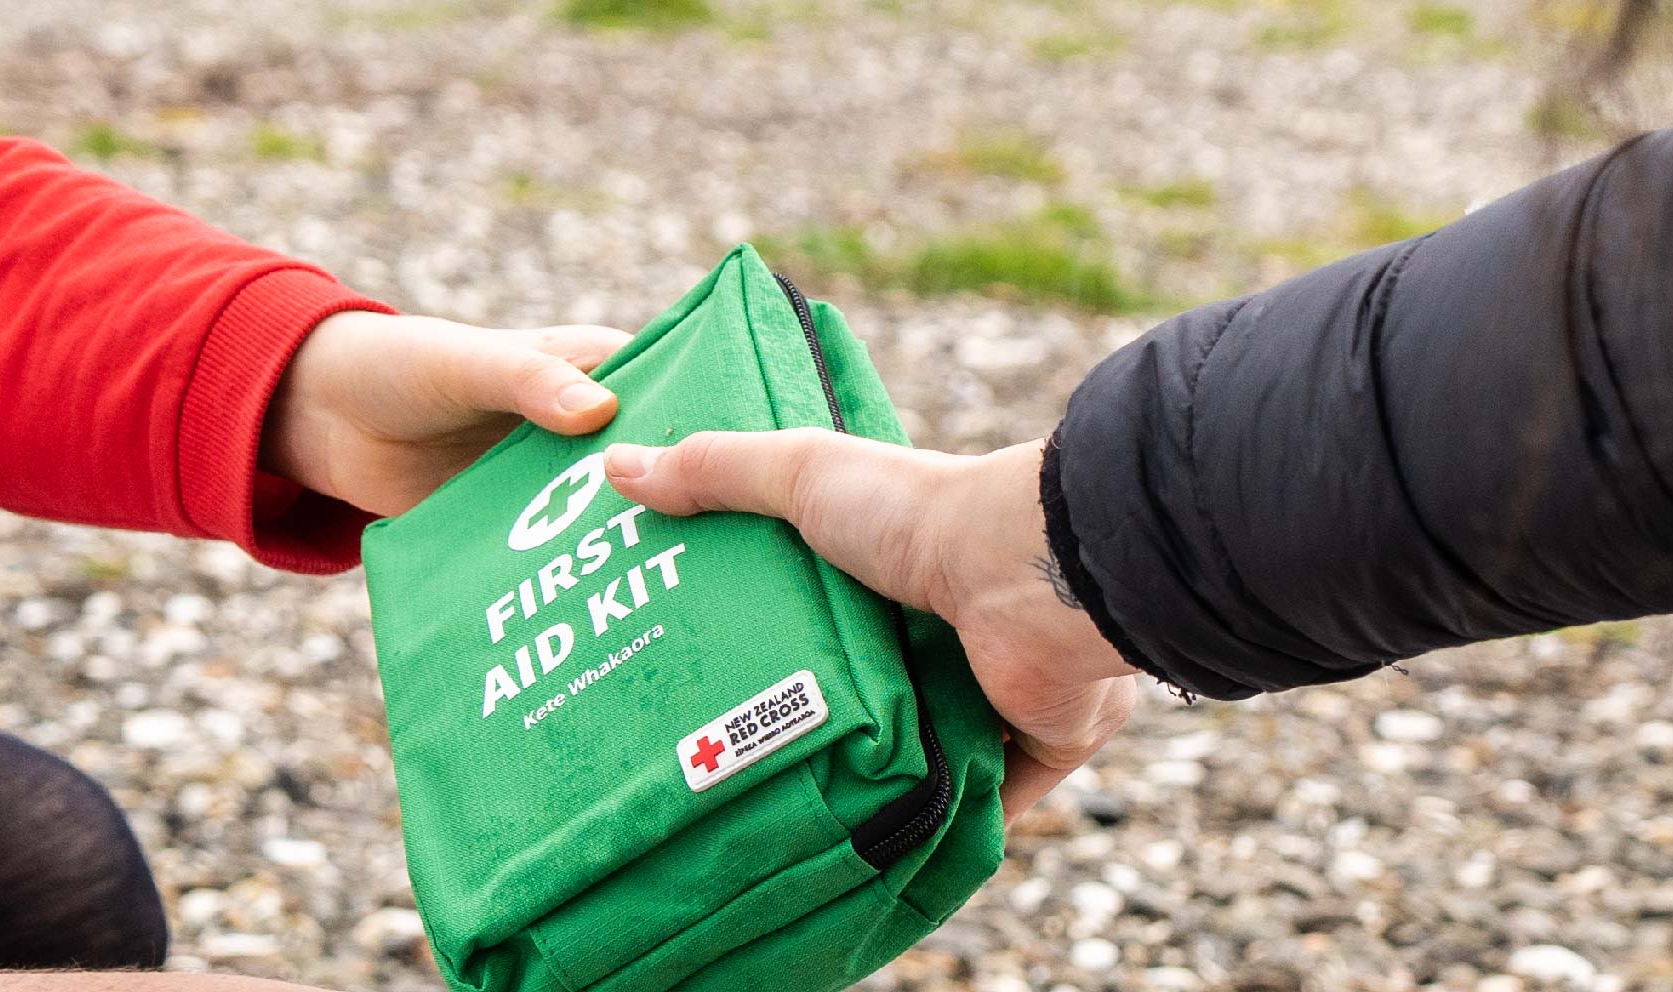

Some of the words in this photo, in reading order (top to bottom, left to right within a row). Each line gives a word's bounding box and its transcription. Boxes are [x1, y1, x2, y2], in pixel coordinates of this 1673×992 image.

[485, 504, 646, 645] FIRST
[482, 622, 575, 719] AID
[587, 543, 686, 638] KIT
[523, 693, 566, 730] Kete
[567, 624, 665, 696] Whakaora
[725, 710, 752, 733] NEW
[753, 682, 804, 717] ZEALAND
[729, 721, 758, 746] RED
[760, 693, 809, 728] CROSS
